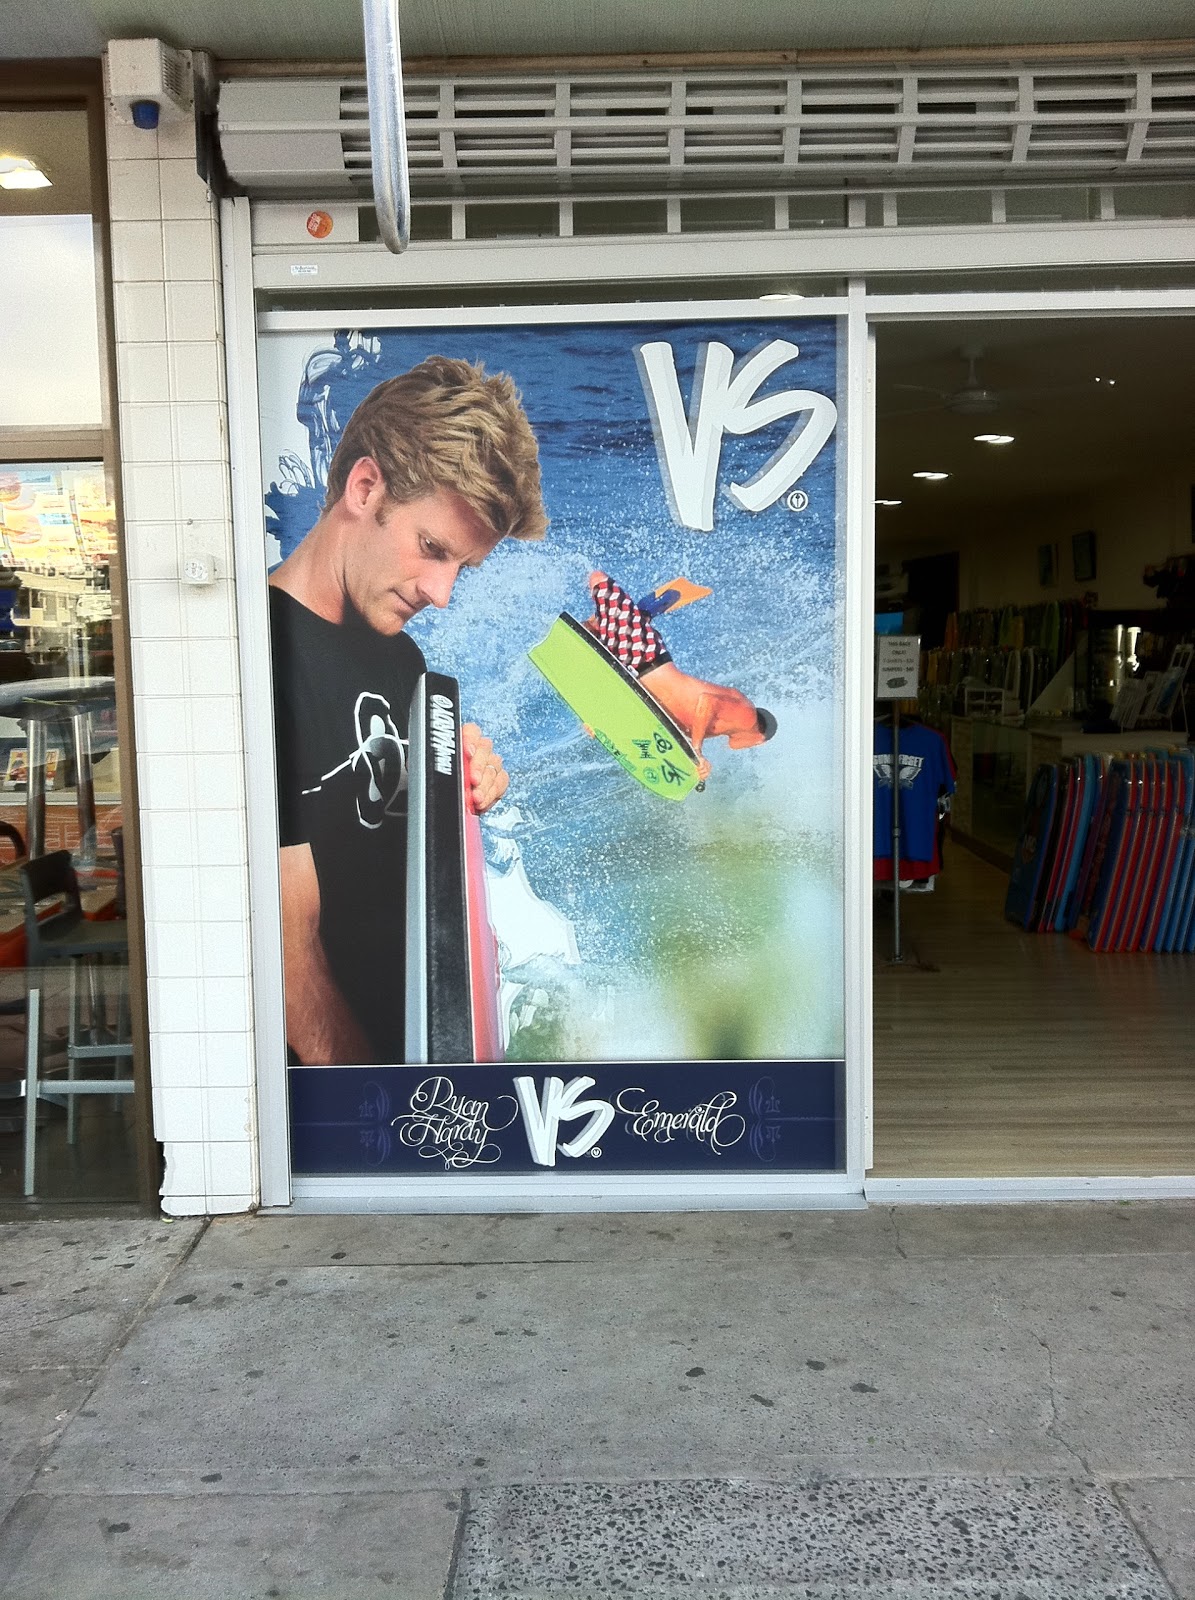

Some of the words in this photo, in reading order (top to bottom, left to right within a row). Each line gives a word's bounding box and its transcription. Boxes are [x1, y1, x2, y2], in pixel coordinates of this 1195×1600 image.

[634, 338, 838, 532] VS
[410, 1076, 519, 1131] Ryan
[616, 1087, 746, 1156] Emerald
[390, 1113, 502, 1170] Hardy
